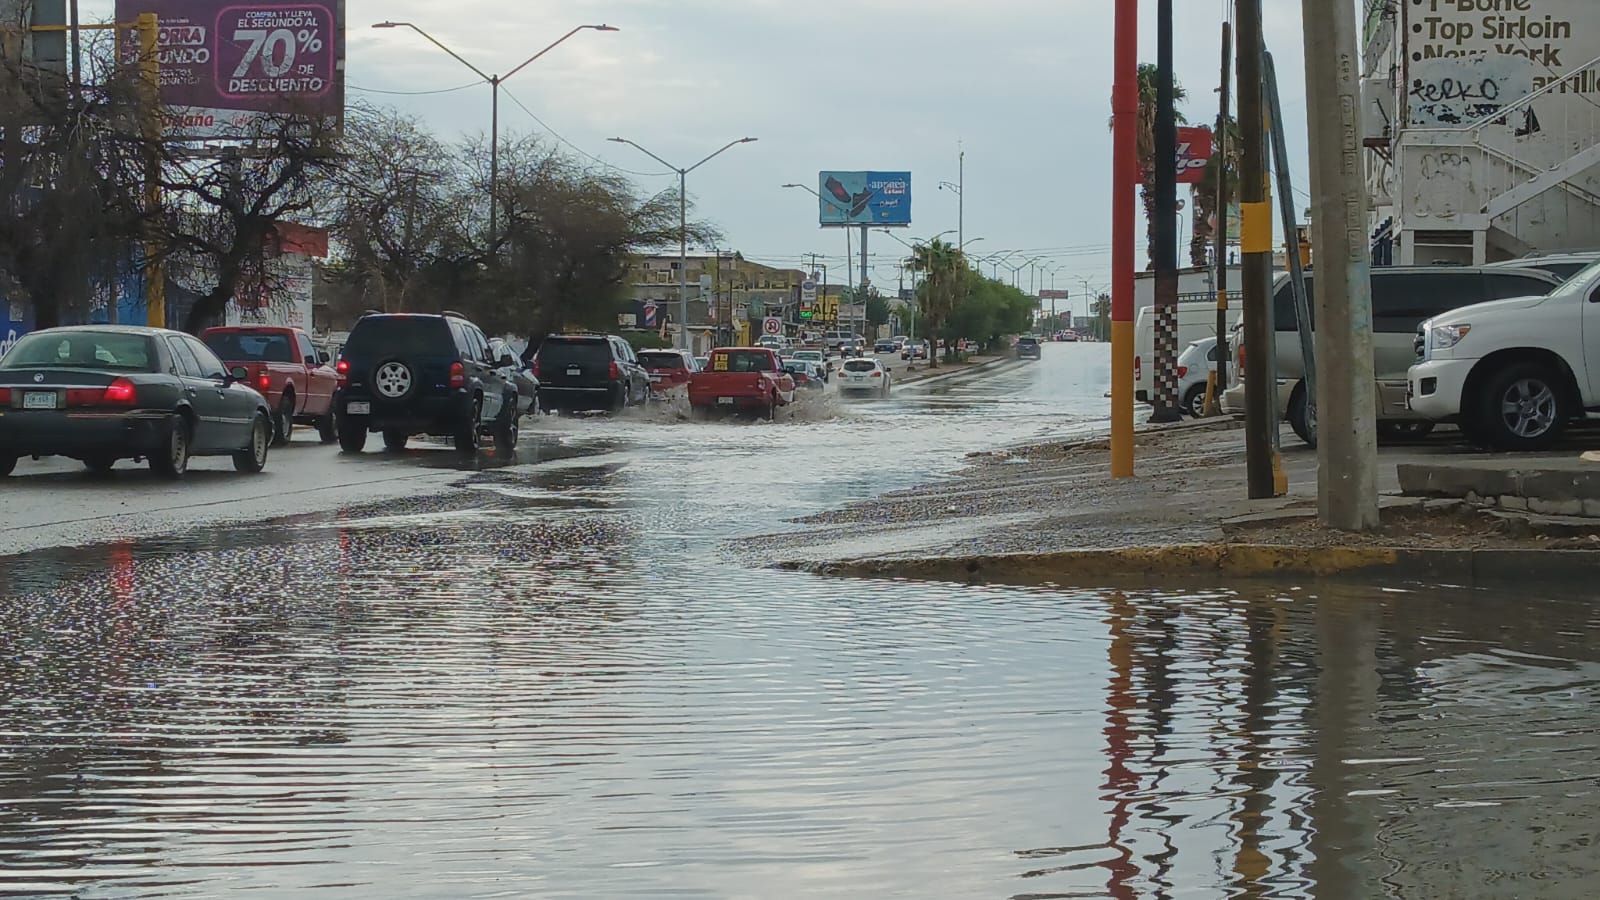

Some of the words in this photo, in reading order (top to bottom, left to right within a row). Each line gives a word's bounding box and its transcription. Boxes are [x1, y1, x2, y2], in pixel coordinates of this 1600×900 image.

[245, 11, 277, 19] COMPRA
[291, 10, 313, 18] LLEVA
[238, 19, 249, 28] EL
[251, 18, 302, 28] SEGUNDO
[304, 18, 319, 27] AL
[1424, 17, 1474, 45] Top
[1482, 15, 1571, 39] Sirloin
[232, 28, 323, 77] 70%
[298, 64, 315, 75] DE
[228, 77, 323, 93] DESCUENTO
